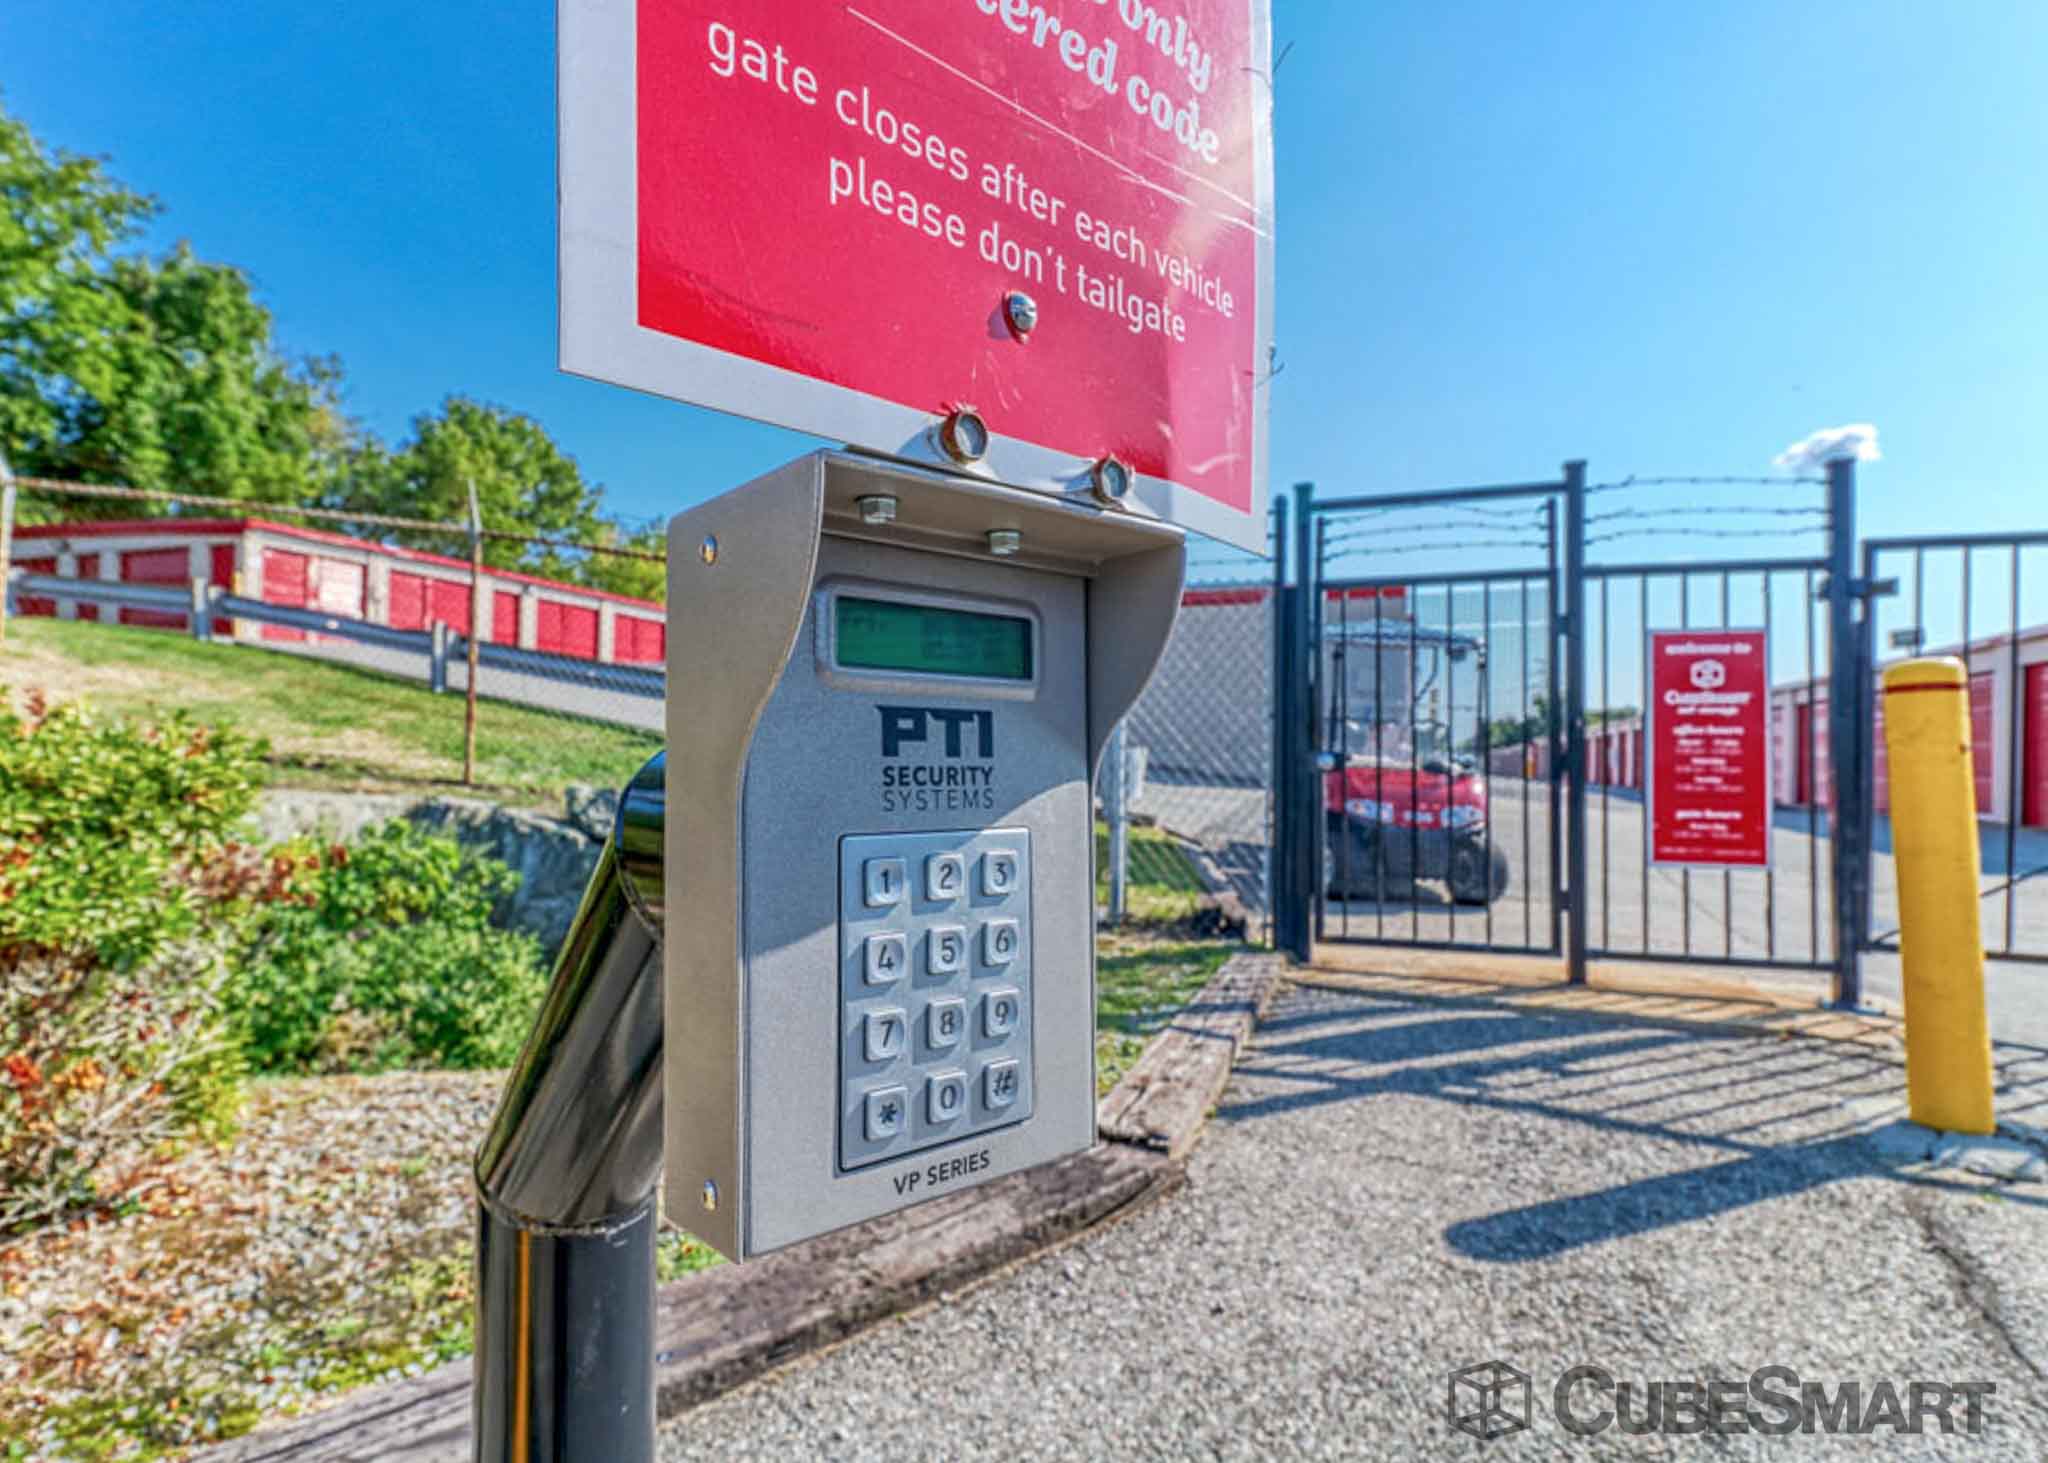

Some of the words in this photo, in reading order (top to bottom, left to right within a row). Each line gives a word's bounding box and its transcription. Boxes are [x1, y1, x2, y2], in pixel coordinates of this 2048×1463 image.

[1119, 0, 1212, 93] only
[1126, 75, 1220, 164] code
[708, 22, 818, 105] gate
[835, 85, 969, 181] closes
[981, 163, 1066, 226] after
[1075, 211, 1147, 268] each
[1154, 249, 1234, 318] vehicle
[829, 156, 966, 247] please
[979, 221, 1067, 294] don't
[1076, 264, 1186, 342] tailgate
[874, 705, 994, 758] PTI
[882, 765, 994, 787] SECURITY
[882, 787, 994, 813] SYSTEMS
[881, 868, 890, 894] 1
[939, 863, 954, 890] 2
[993, 861, 1007, 886] 3
[878, 944, 895, 971] 4
[941, 937, 955, 964] 5
[995, 928, 1009, 952] 6
[880, 1020, 894, 1048] 7
[940, 1010, 955, 1036] 8
[995, 1001, 1008, 1026] 9
[941, 1084, 956, 1110] 0
[893, 1170, 920, 1195] VP
[927, 1150, 991, 1187] SERIES
